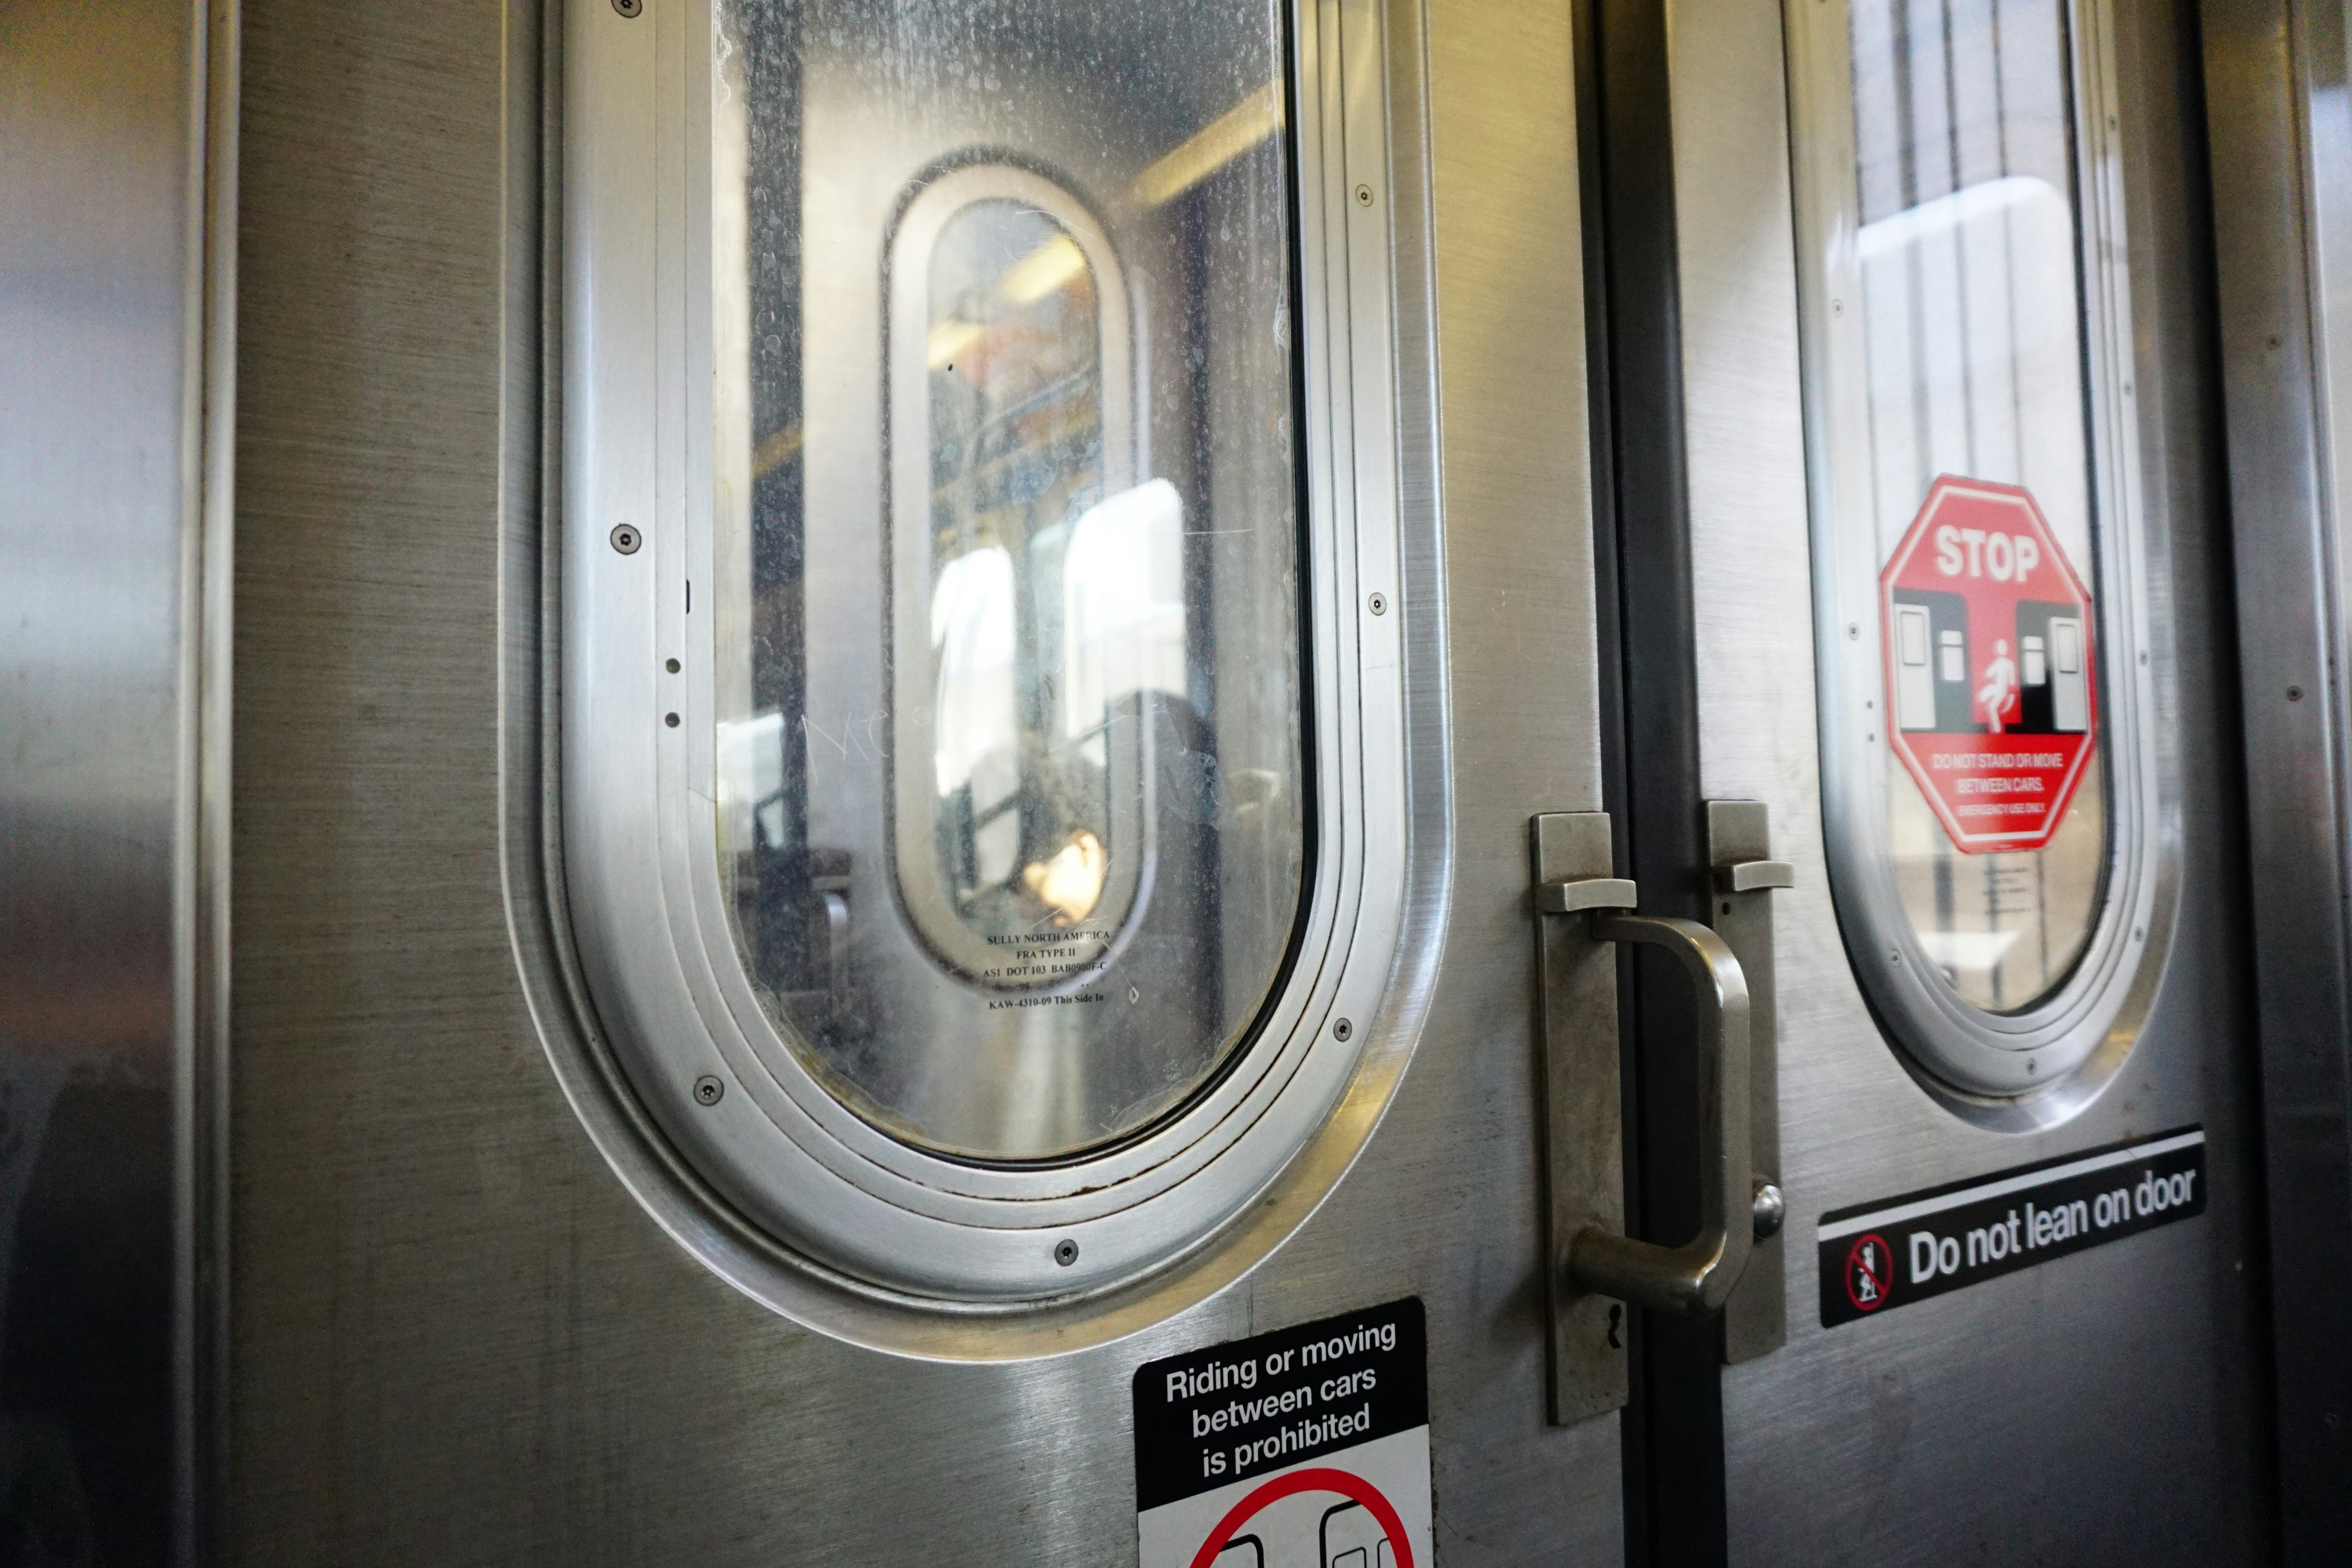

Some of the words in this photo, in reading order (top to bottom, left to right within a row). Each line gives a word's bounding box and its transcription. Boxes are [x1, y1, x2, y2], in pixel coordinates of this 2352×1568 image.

[1935, 524, 2038, 582] STOP
[1933, 754, 1951, 769] DO
[1953, 753, 1977, 768] NOT
[1979, 753, 2013, 768] STAND
[2016, 753, 2032, 768] OR
[2033, 753, 2063, 767] MOVE
[1957, 778, 2011, 793] BETWEEN
[987, 935, 1020, 945] SULLY
[1024, 933, 1060, 943] NORTH
[1063, 931, 1109, 941] AMERICA
[1016, 951, 1036, 959] FRA
[1040, 949, 1065, 958] TYPE
[1069, 948, 1075, 956] II
[1007, 966, 1029, 976] DOT
[1032, 965, 1046, 975] 103
[989, 998, 1051, 1010] KAW-4310-09
[1054, 995, 1072, 1005] This
[1075, 994, 1093, 1003] Side
[1909, 1231, 1960, 1284] Do
[1967, 1210, 2022, 1267] not
[2025, 1201, 2088, 1250] lean
[2093, 1190, 2130, 1228] on
[2135, 1169, 2196, 1217] door
[1166, 1359, 1257, 1402] Riding
[1266, 1349, 1294, 1376] or
[1301, 1323, 1396, 1367] moving
[1192, 1386, 1312, 1438] between
[1320, 1368, 1376, 1401] cars
[1203, 1448, 1226, 1477] is
[1234, 1403, 1370, 1475] prohibited
